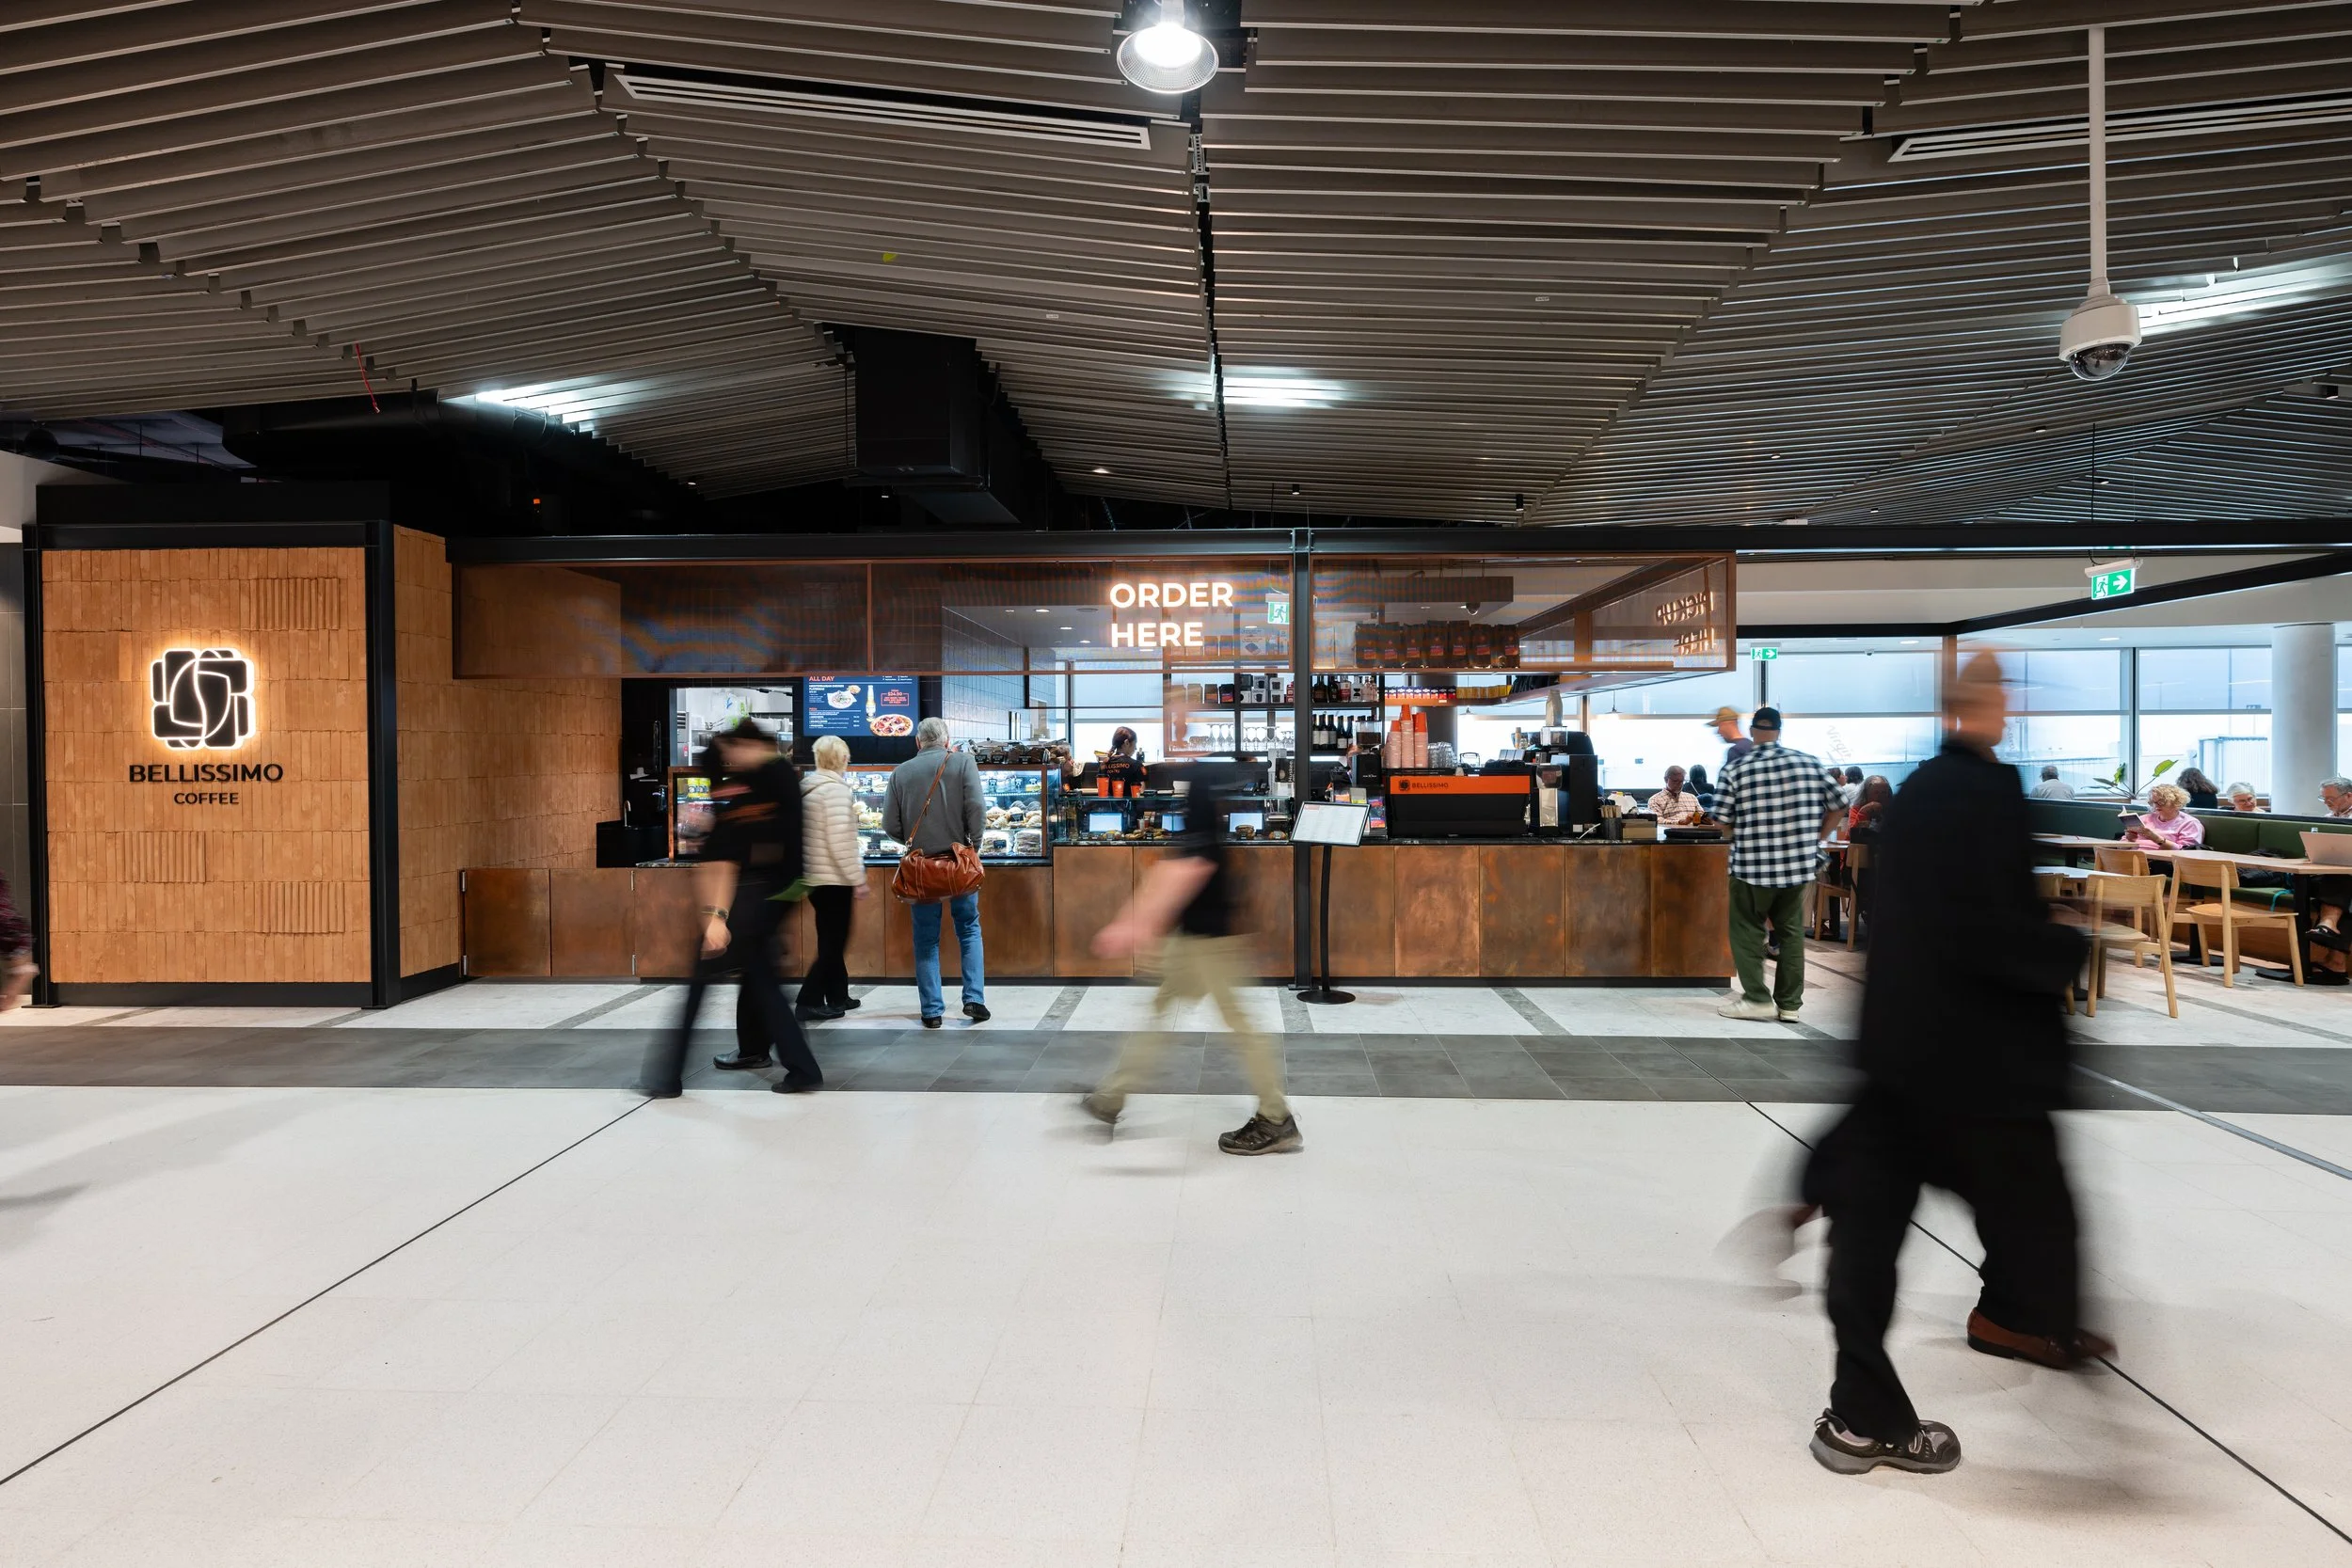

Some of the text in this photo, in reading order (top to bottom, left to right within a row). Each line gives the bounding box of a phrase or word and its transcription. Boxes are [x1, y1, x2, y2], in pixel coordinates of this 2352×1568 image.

[1109, 581, 1233, 609] ORDER
[1111, 621, 1204, 648] HERE
[129, 764, 283, 783] BELLISSIMO
[174, 792, 240, 805] COFFEE
